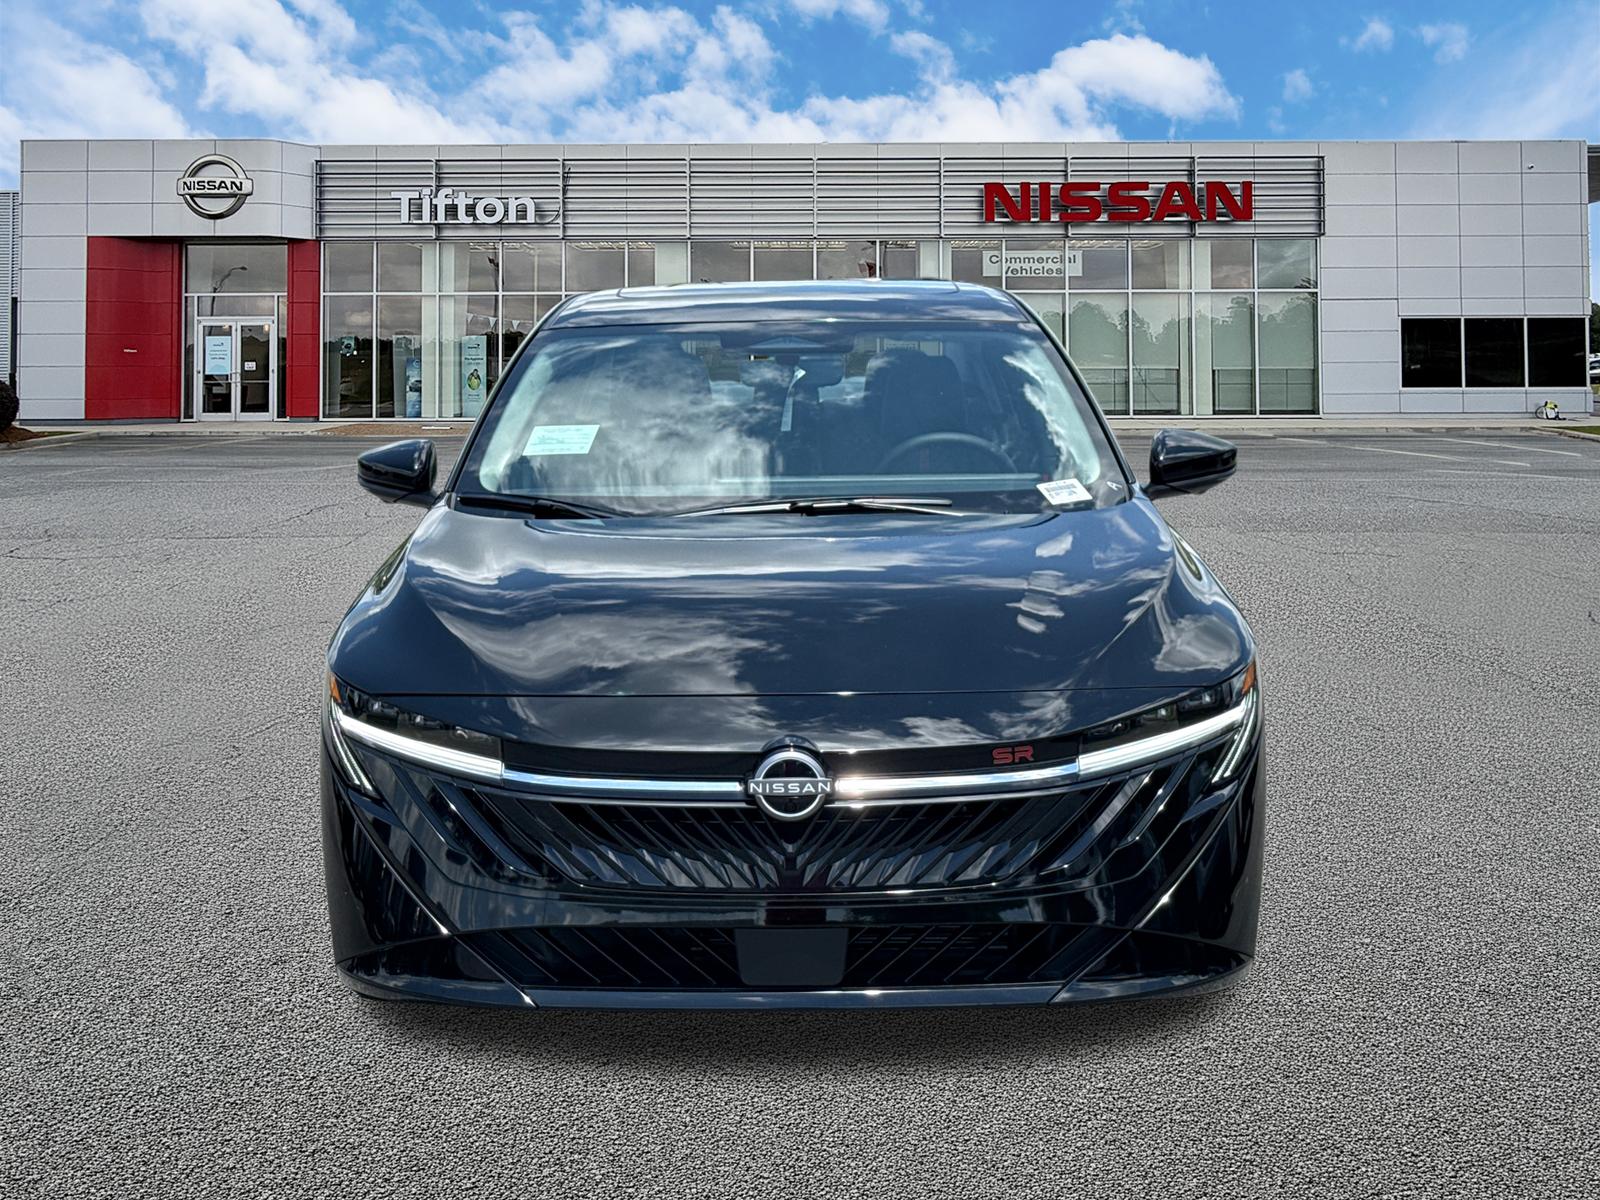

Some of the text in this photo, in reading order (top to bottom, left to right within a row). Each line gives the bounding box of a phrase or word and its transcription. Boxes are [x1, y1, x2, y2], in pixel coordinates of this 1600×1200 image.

[182, 180, 243, 191] NISSAN
[391, 187, 536, 224] Tifton
[983, 181, 1254, 222] NISSAN
[992, 745, 1034, 764] SR
[749, 782, 831, 793] NISSAN
